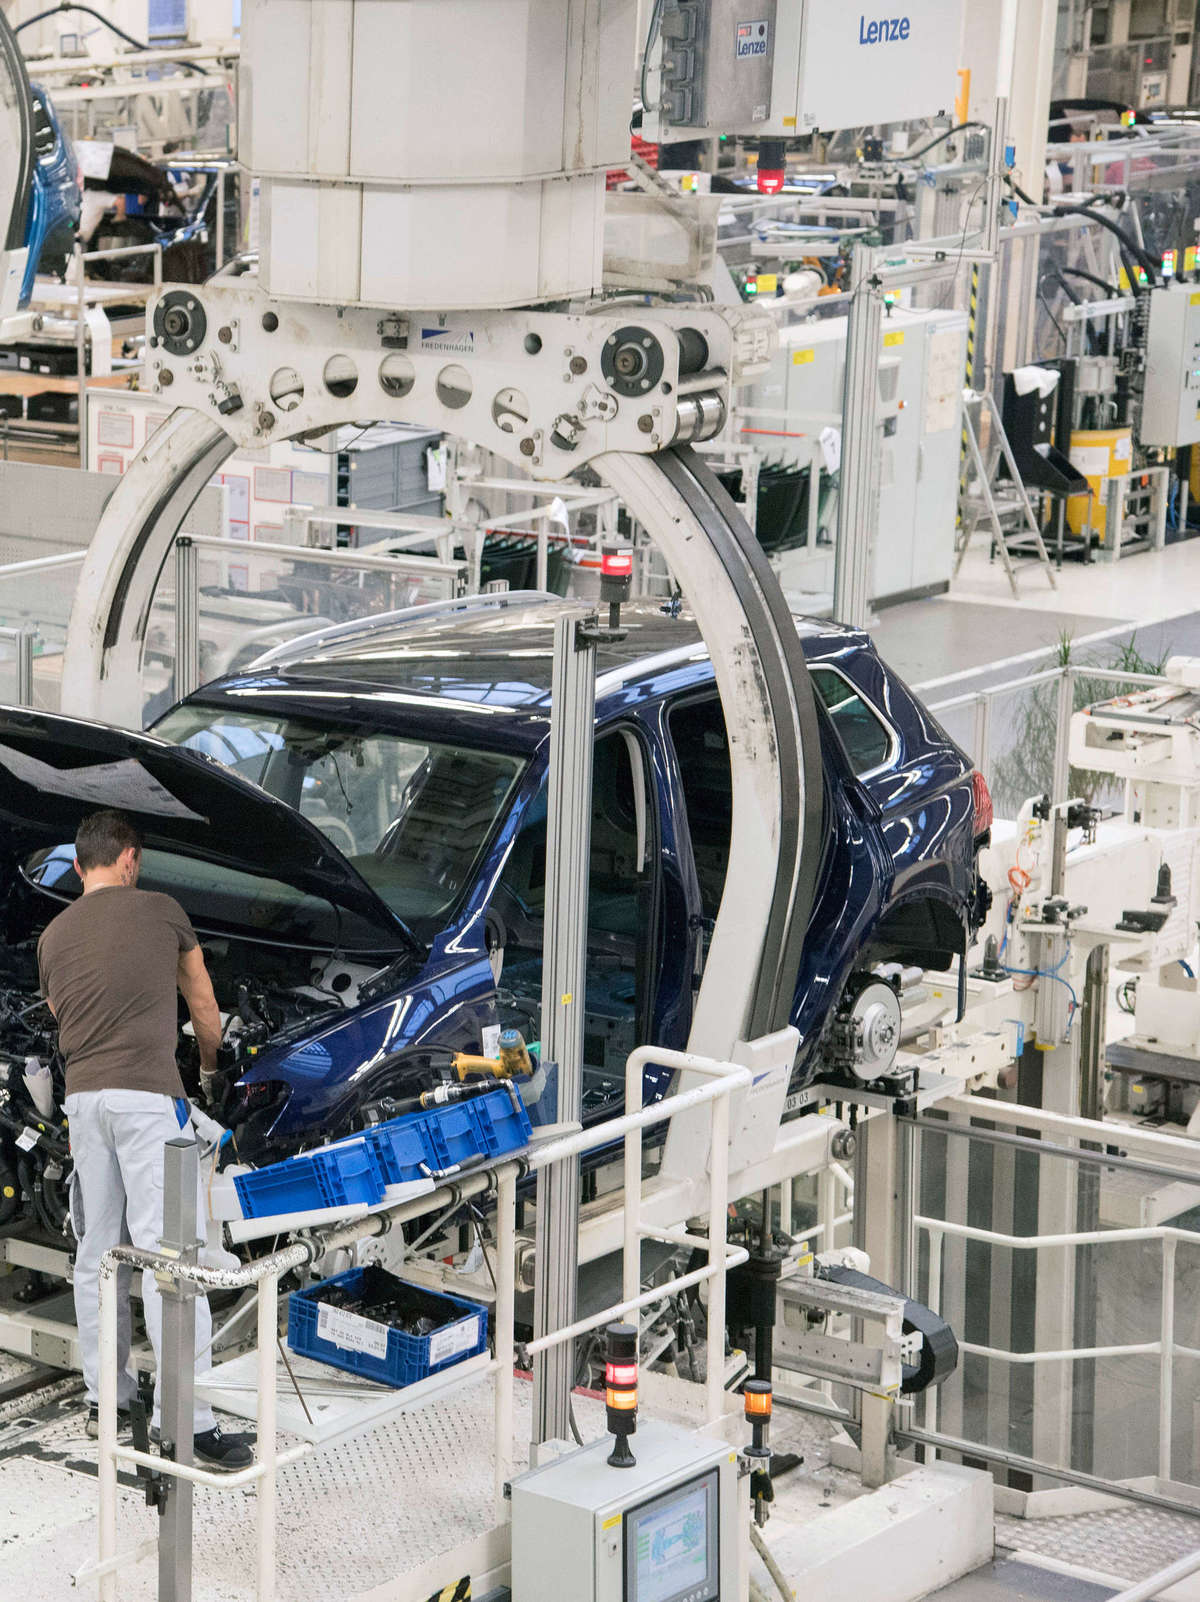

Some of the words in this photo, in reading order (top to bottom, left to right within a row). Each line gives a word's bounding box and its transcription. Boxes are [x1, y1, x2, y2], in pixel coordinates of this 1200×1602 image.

[859, 15, 910, 45] Lenze
[738, 40, 766, 56] Lenze
[421, 341, 474, 353] FREDENHAGEN
[799, 1091, 809, 1105] 03
